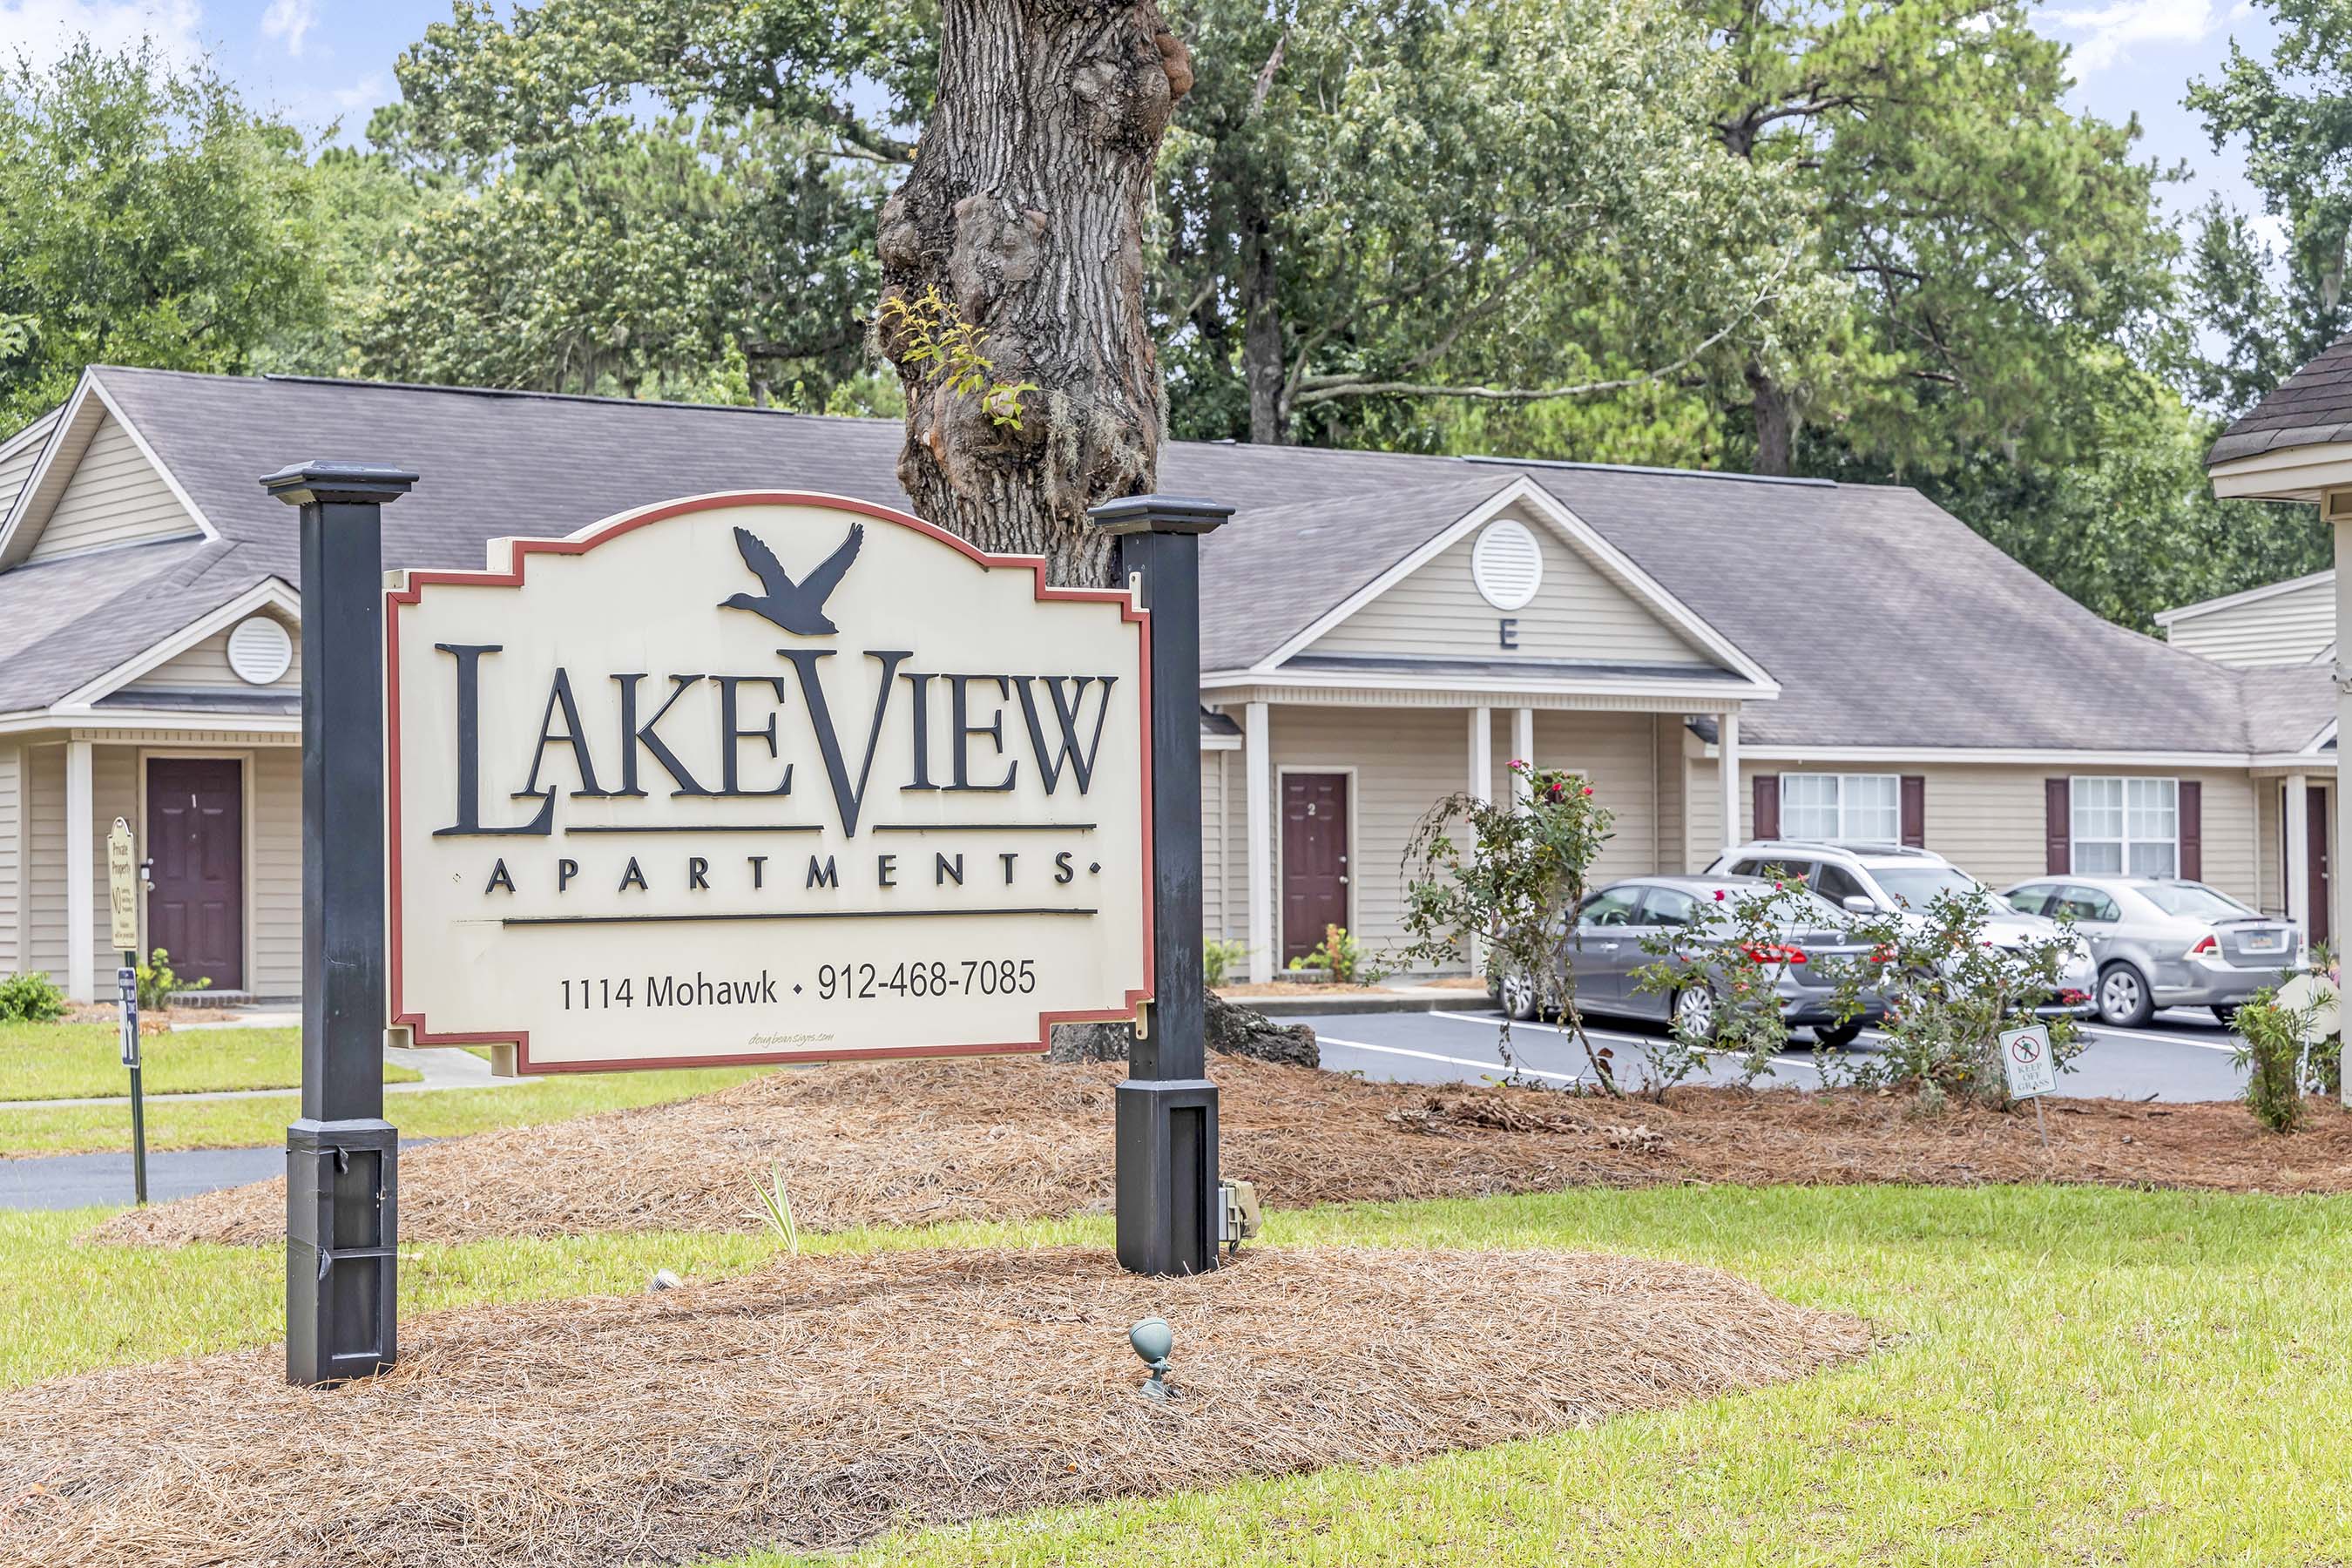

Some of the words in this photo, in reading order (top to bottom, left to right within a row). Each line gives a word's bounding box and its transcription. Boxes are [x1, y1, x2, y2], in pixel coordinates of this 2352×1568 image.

[1500, 618, 1518, 650] E
[434, 643, 1119, 838] LAKEVIEW
[1308, 803, 1315, 816] 2
[561, 978, 634, 1010] 1114
[646, 970, 778, 1007] Mohawk
[818, 959, 1036, 1000] 912-468-7085
[2017, 1062, 2043, 1074] KEEP
[2023, 1071, 2041, 1081] OFF
[2017, 1079, 2050, 1092] GRASS
